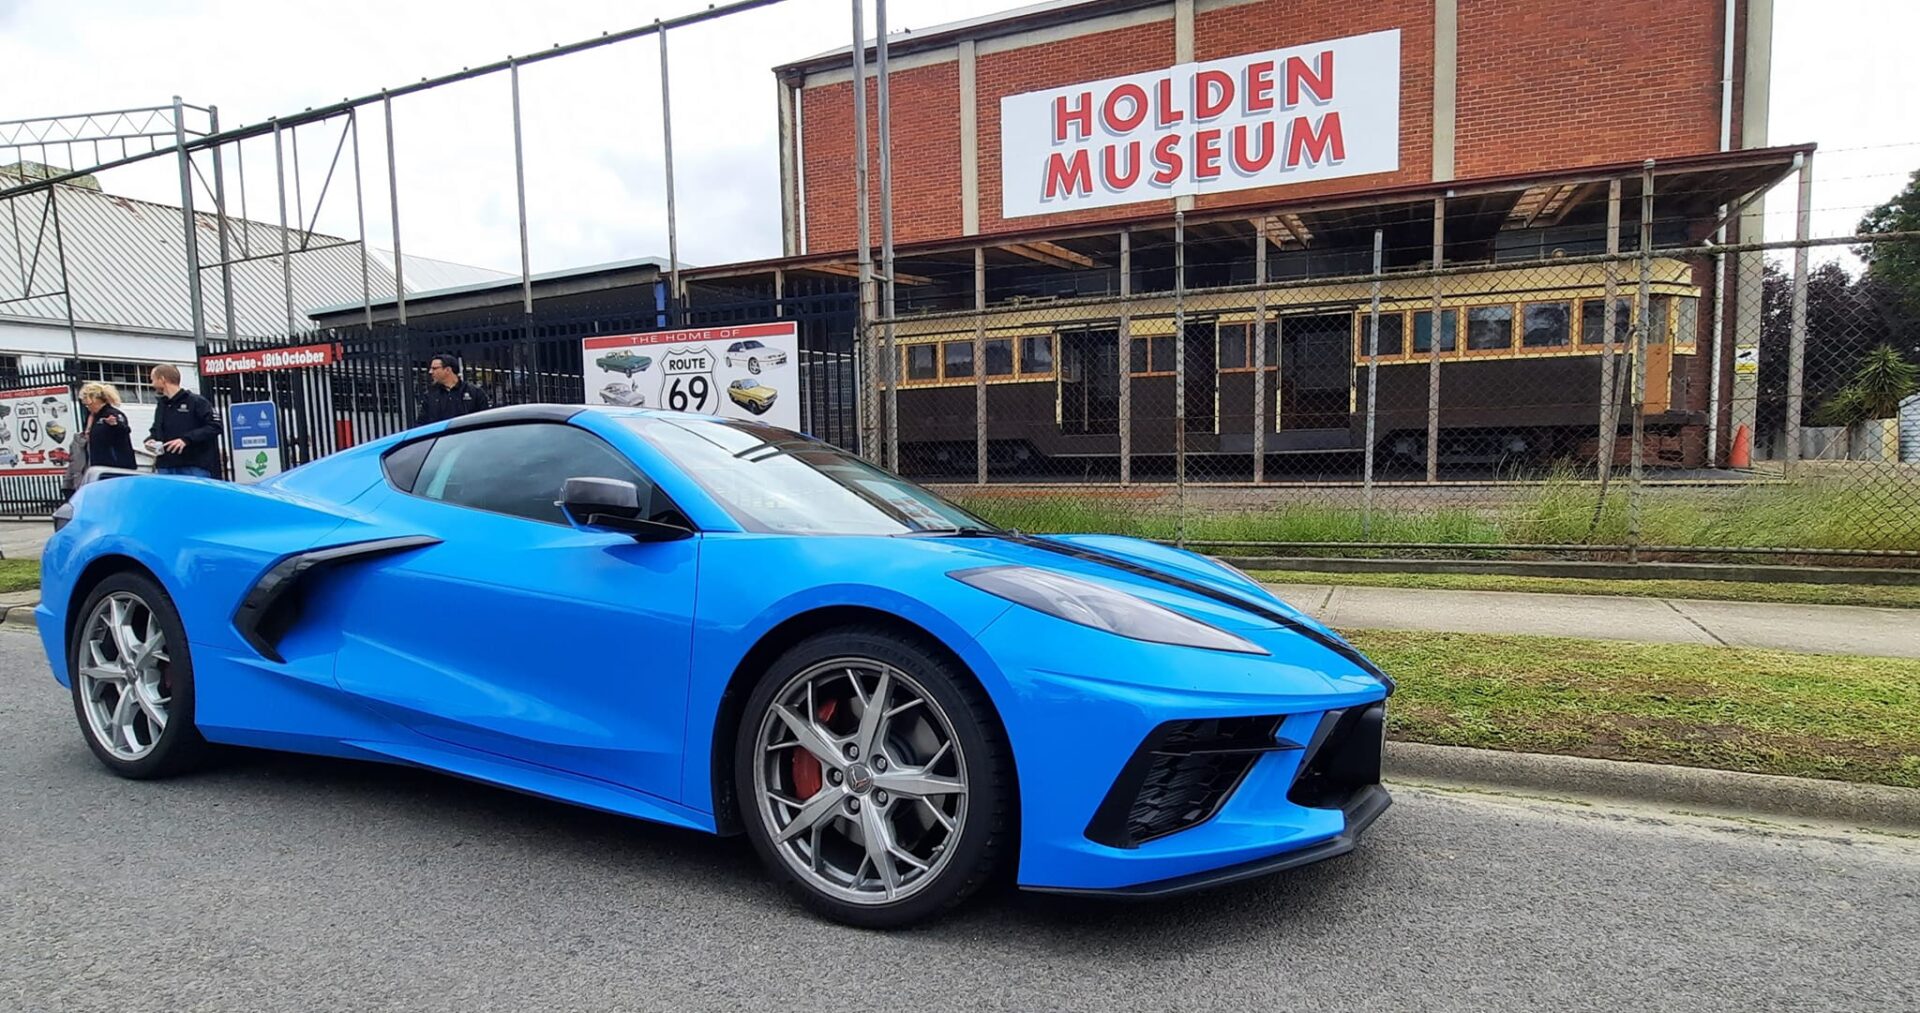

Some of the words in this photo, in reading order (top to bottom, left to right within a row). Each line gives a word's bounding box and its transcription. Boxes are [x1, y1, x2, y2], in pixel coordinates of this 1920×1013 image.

[1053, 50, 1334, 144] HOLDEN
[1040, 111, 1346, 203] MUSEUM
[631, 334, 659, 345] THE
[665, 331, 712, 342] HOME
[720, 329, 741, 337] OF
[205, 358, 225, 373] 2020
[225, 356, 256, 371] Cruise
[668, 357, 706, 371] ROUTE
[668, 375, 709, 411] 69
[18, 407, 34, 415] ROUTE
[21, 419, 38, 443] 69
